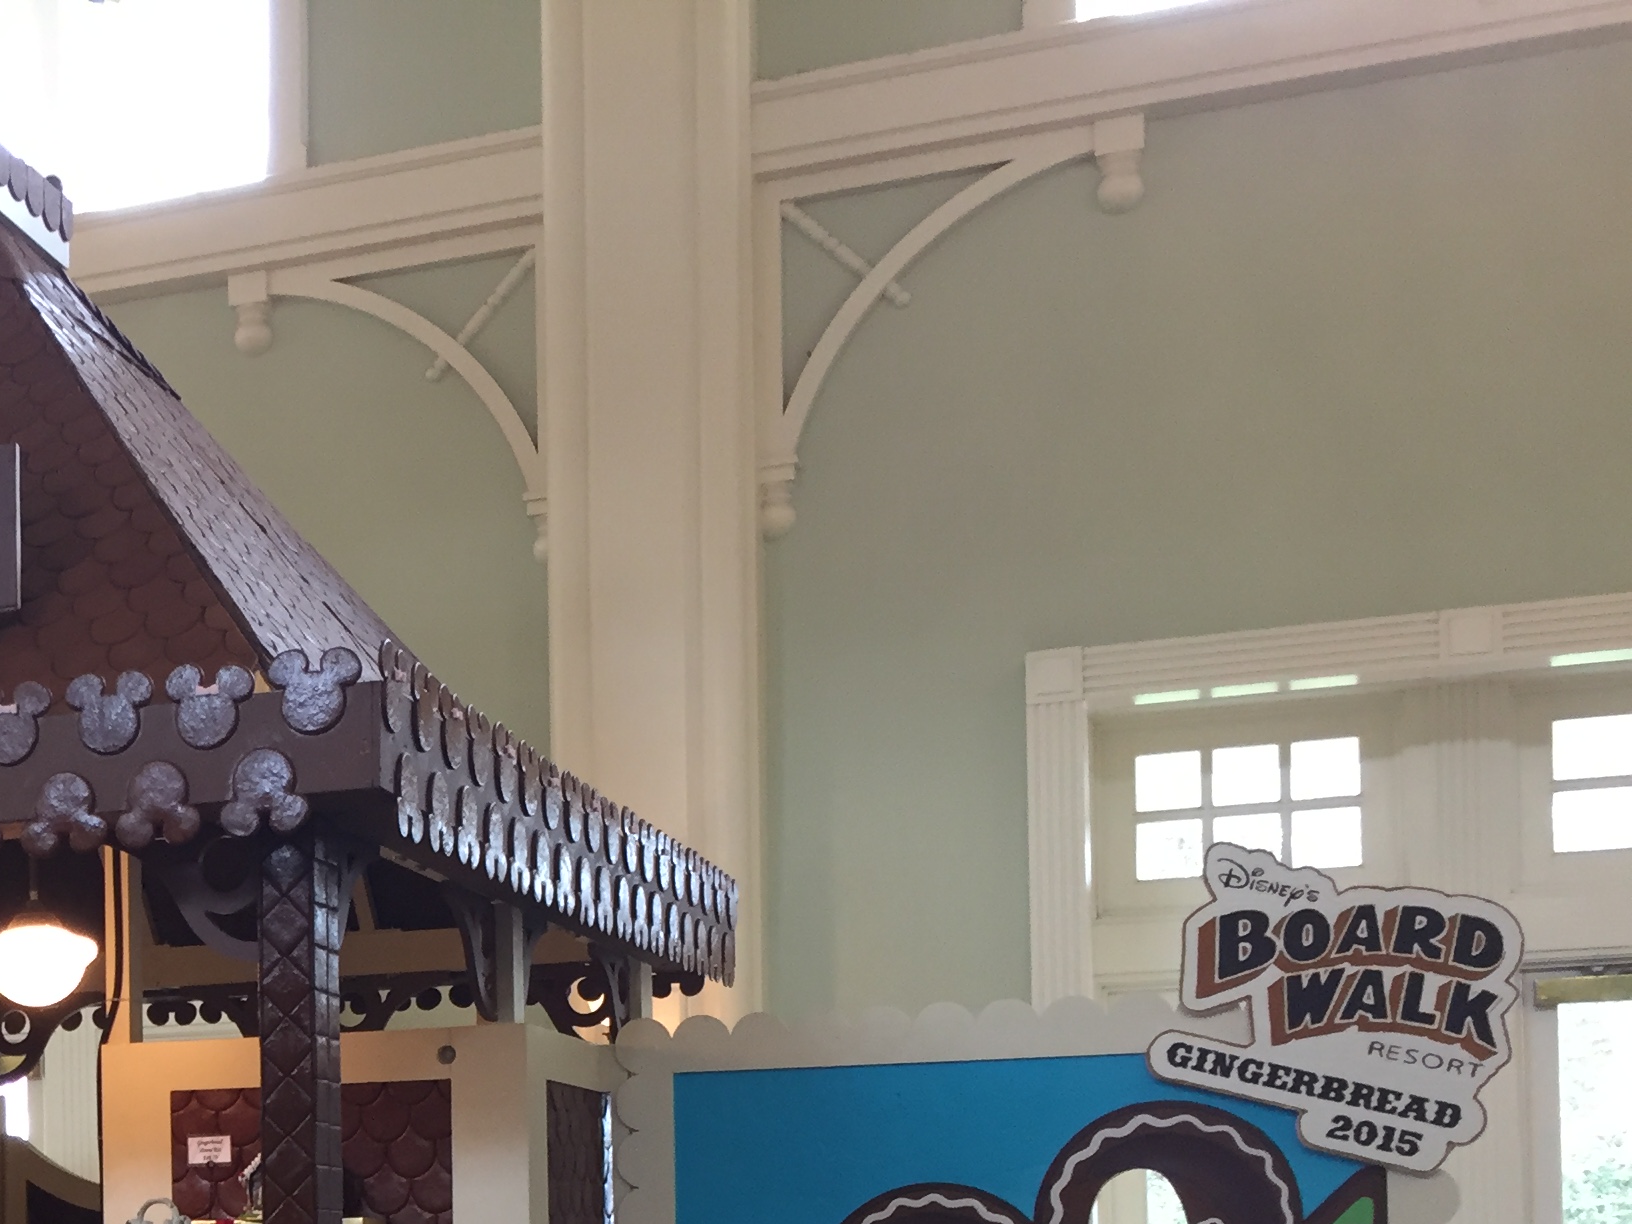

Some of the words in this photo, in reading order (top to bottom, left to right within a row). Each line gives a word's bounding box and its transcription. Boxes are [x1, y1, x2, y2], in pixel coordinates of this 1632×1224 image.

[1196, 904, 1504, 1000] BOARD
[1268, 968, 1499, 1060] WALK
[1167, 1041, 1462, 1129] GINGERBREAD
[1368, 1040, 1484, 1079] RESORT
[1325, 1114, 1424, 1158] 2015
